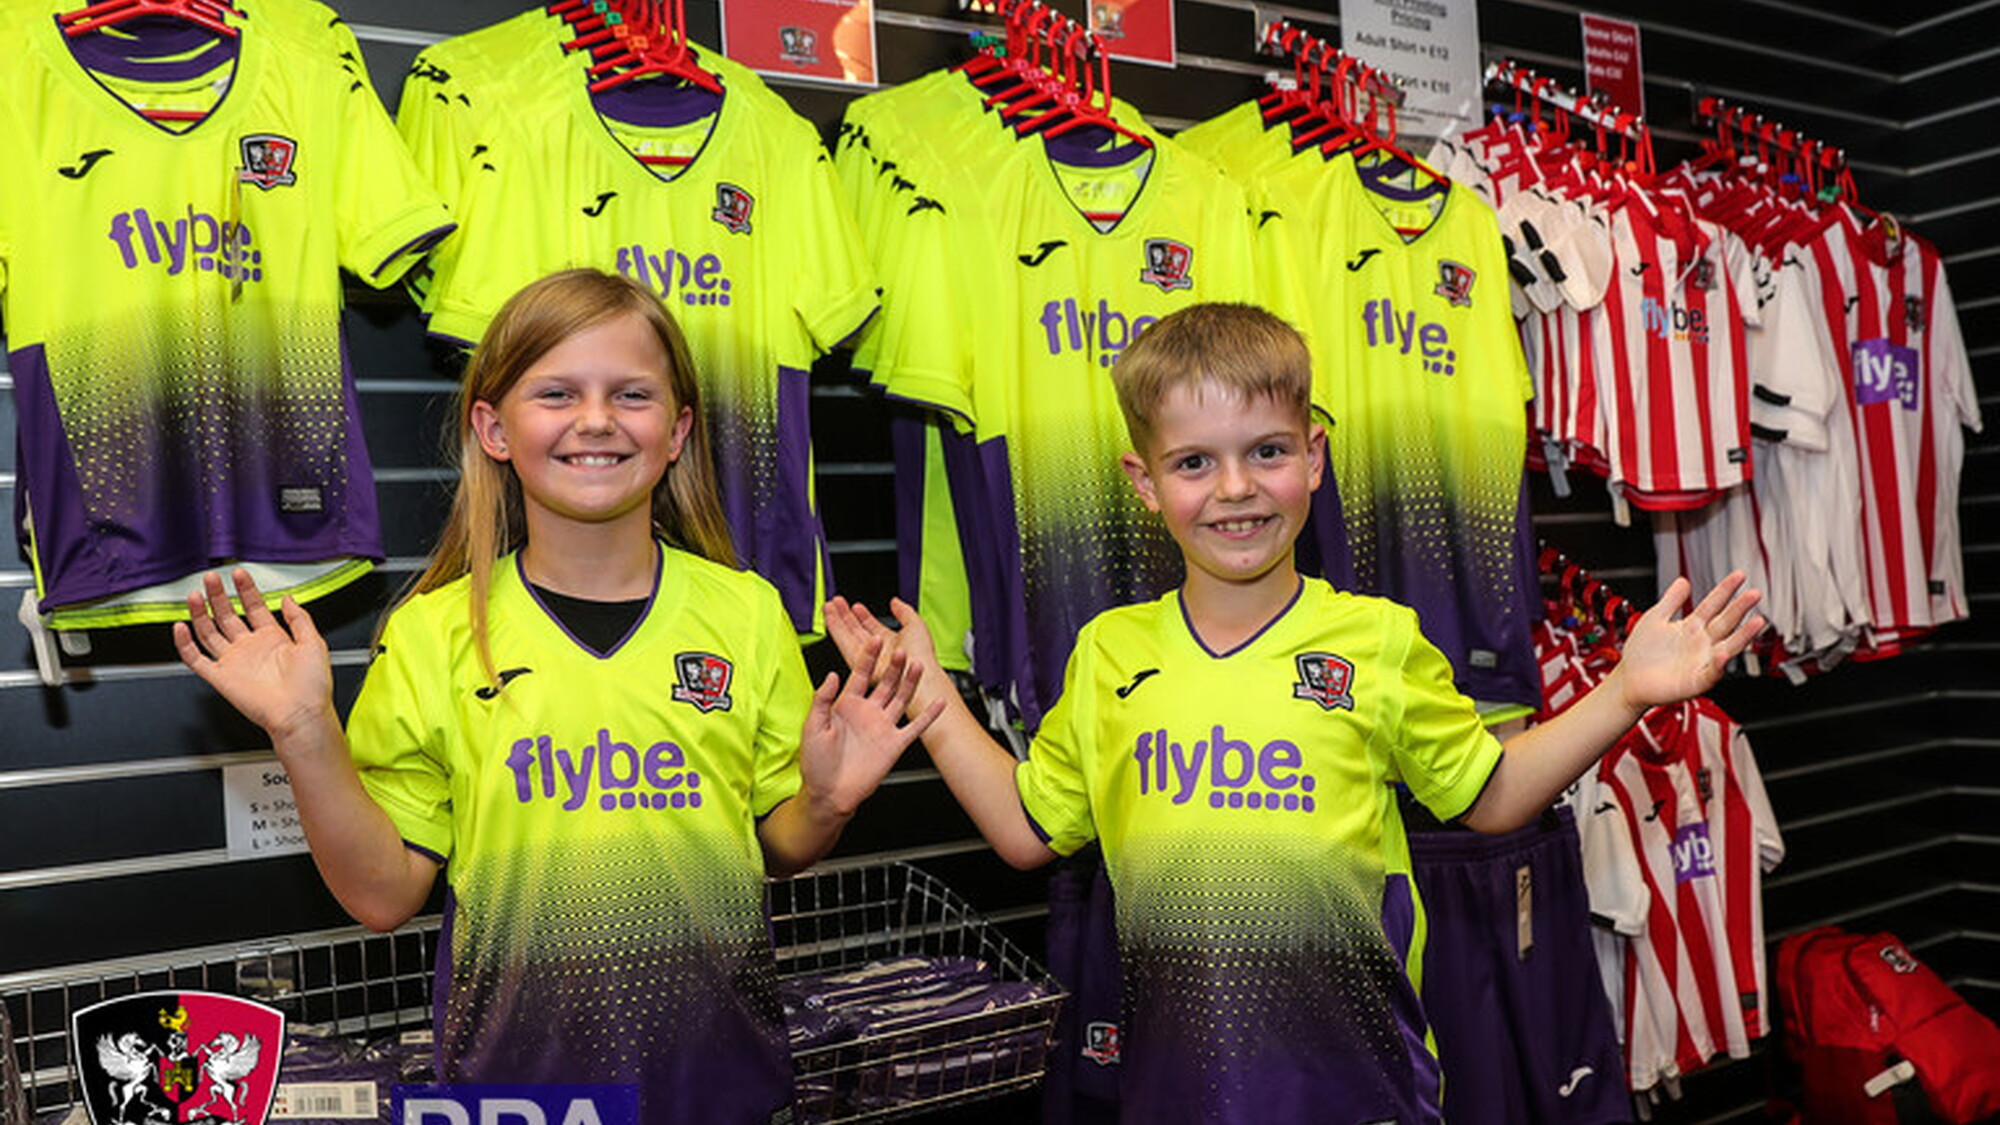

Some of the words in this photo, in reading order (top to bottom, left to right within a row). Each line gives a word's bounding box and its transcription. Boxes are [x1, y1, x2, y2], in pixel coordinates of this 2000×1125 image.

[1356, 31, 1386, 48] Adult
[1389, 37, 1417, 55] Shirt
[252, 820, 266, 831] M
